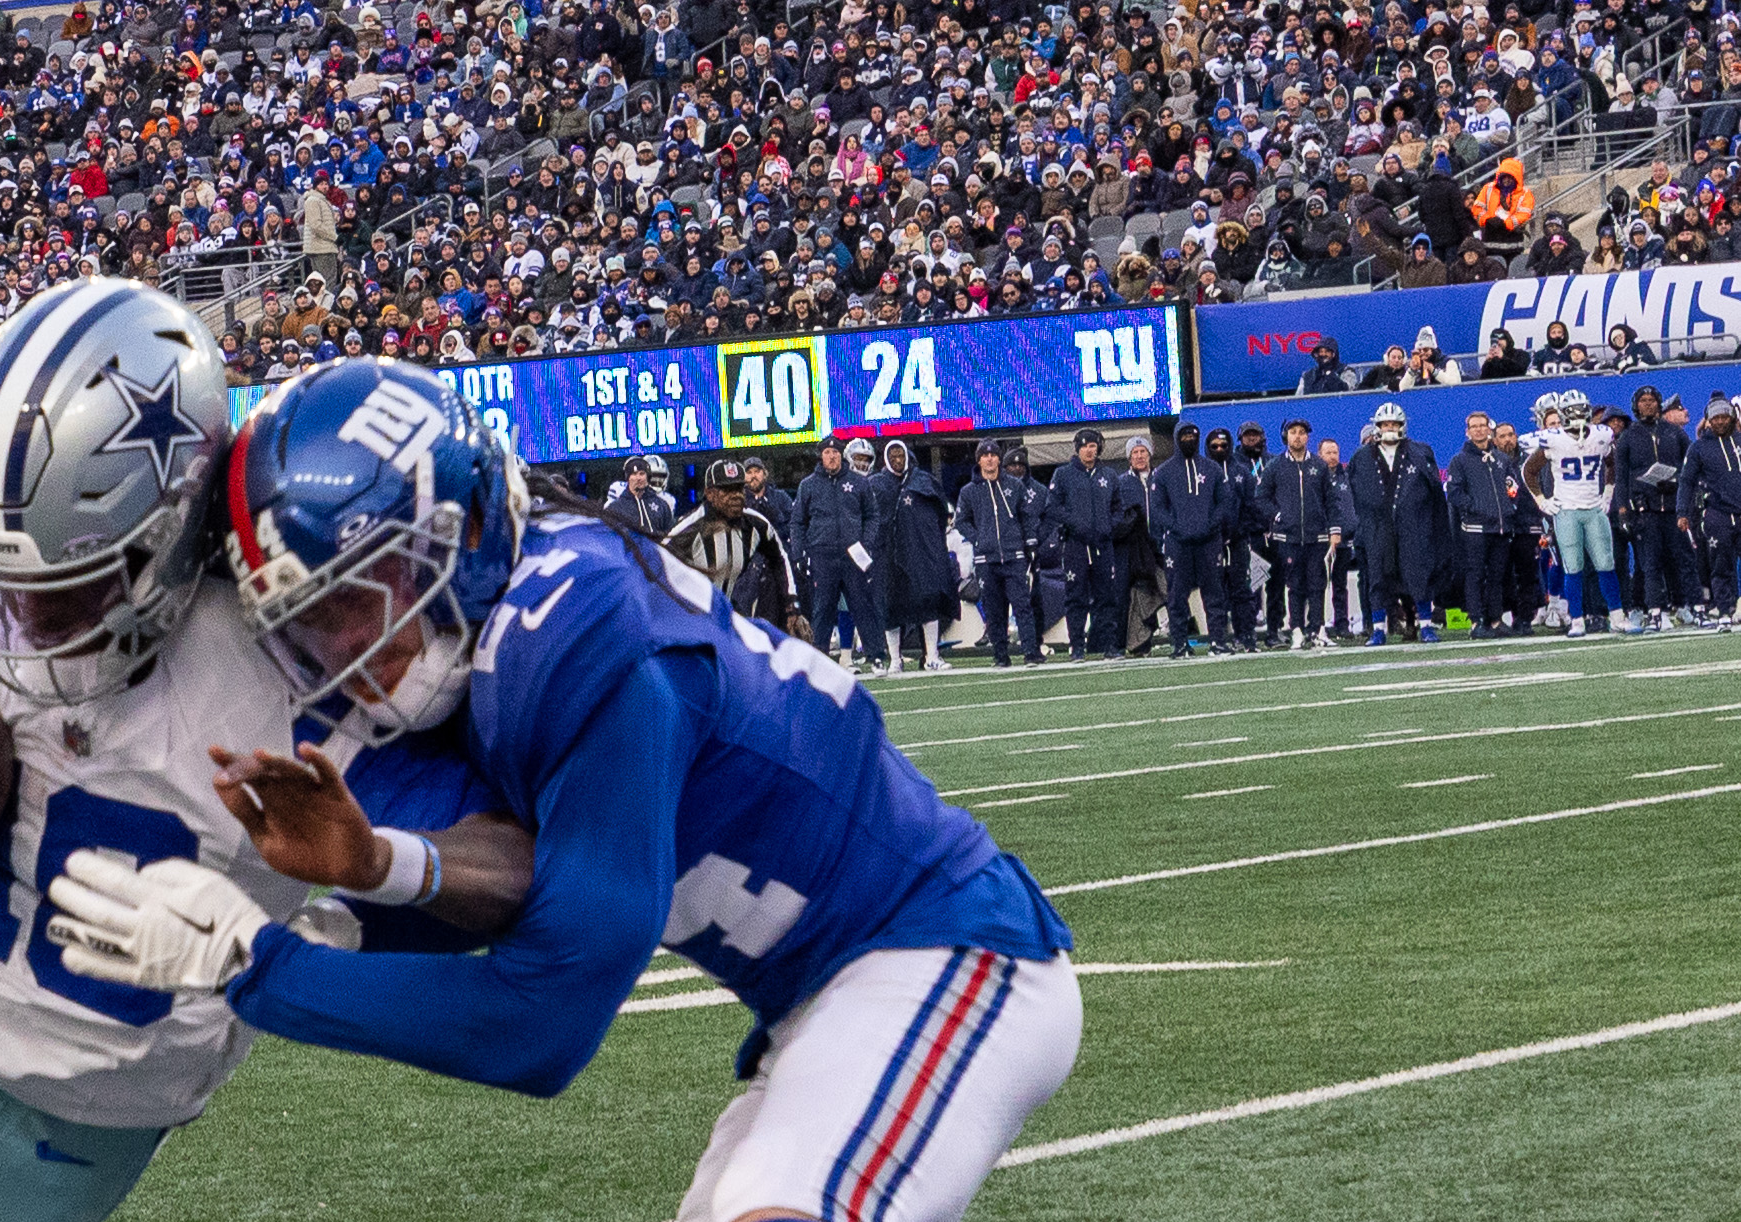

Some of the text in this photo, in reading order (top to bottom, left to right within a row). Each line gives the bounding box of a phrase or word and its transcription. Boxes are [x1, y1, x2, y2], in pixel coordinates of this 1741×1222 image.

[1247, 330, 1322, 357] NYG
[462, 364, 514, 408] QTR
[581, 362, 683, 408] 1ST & 4
[732, 350, 812, 433] 40
[861, 336, 943, 422] 24
[566, 404, 700, 454] BALL ON 4
[1561, 454, 1601, 481] 97
